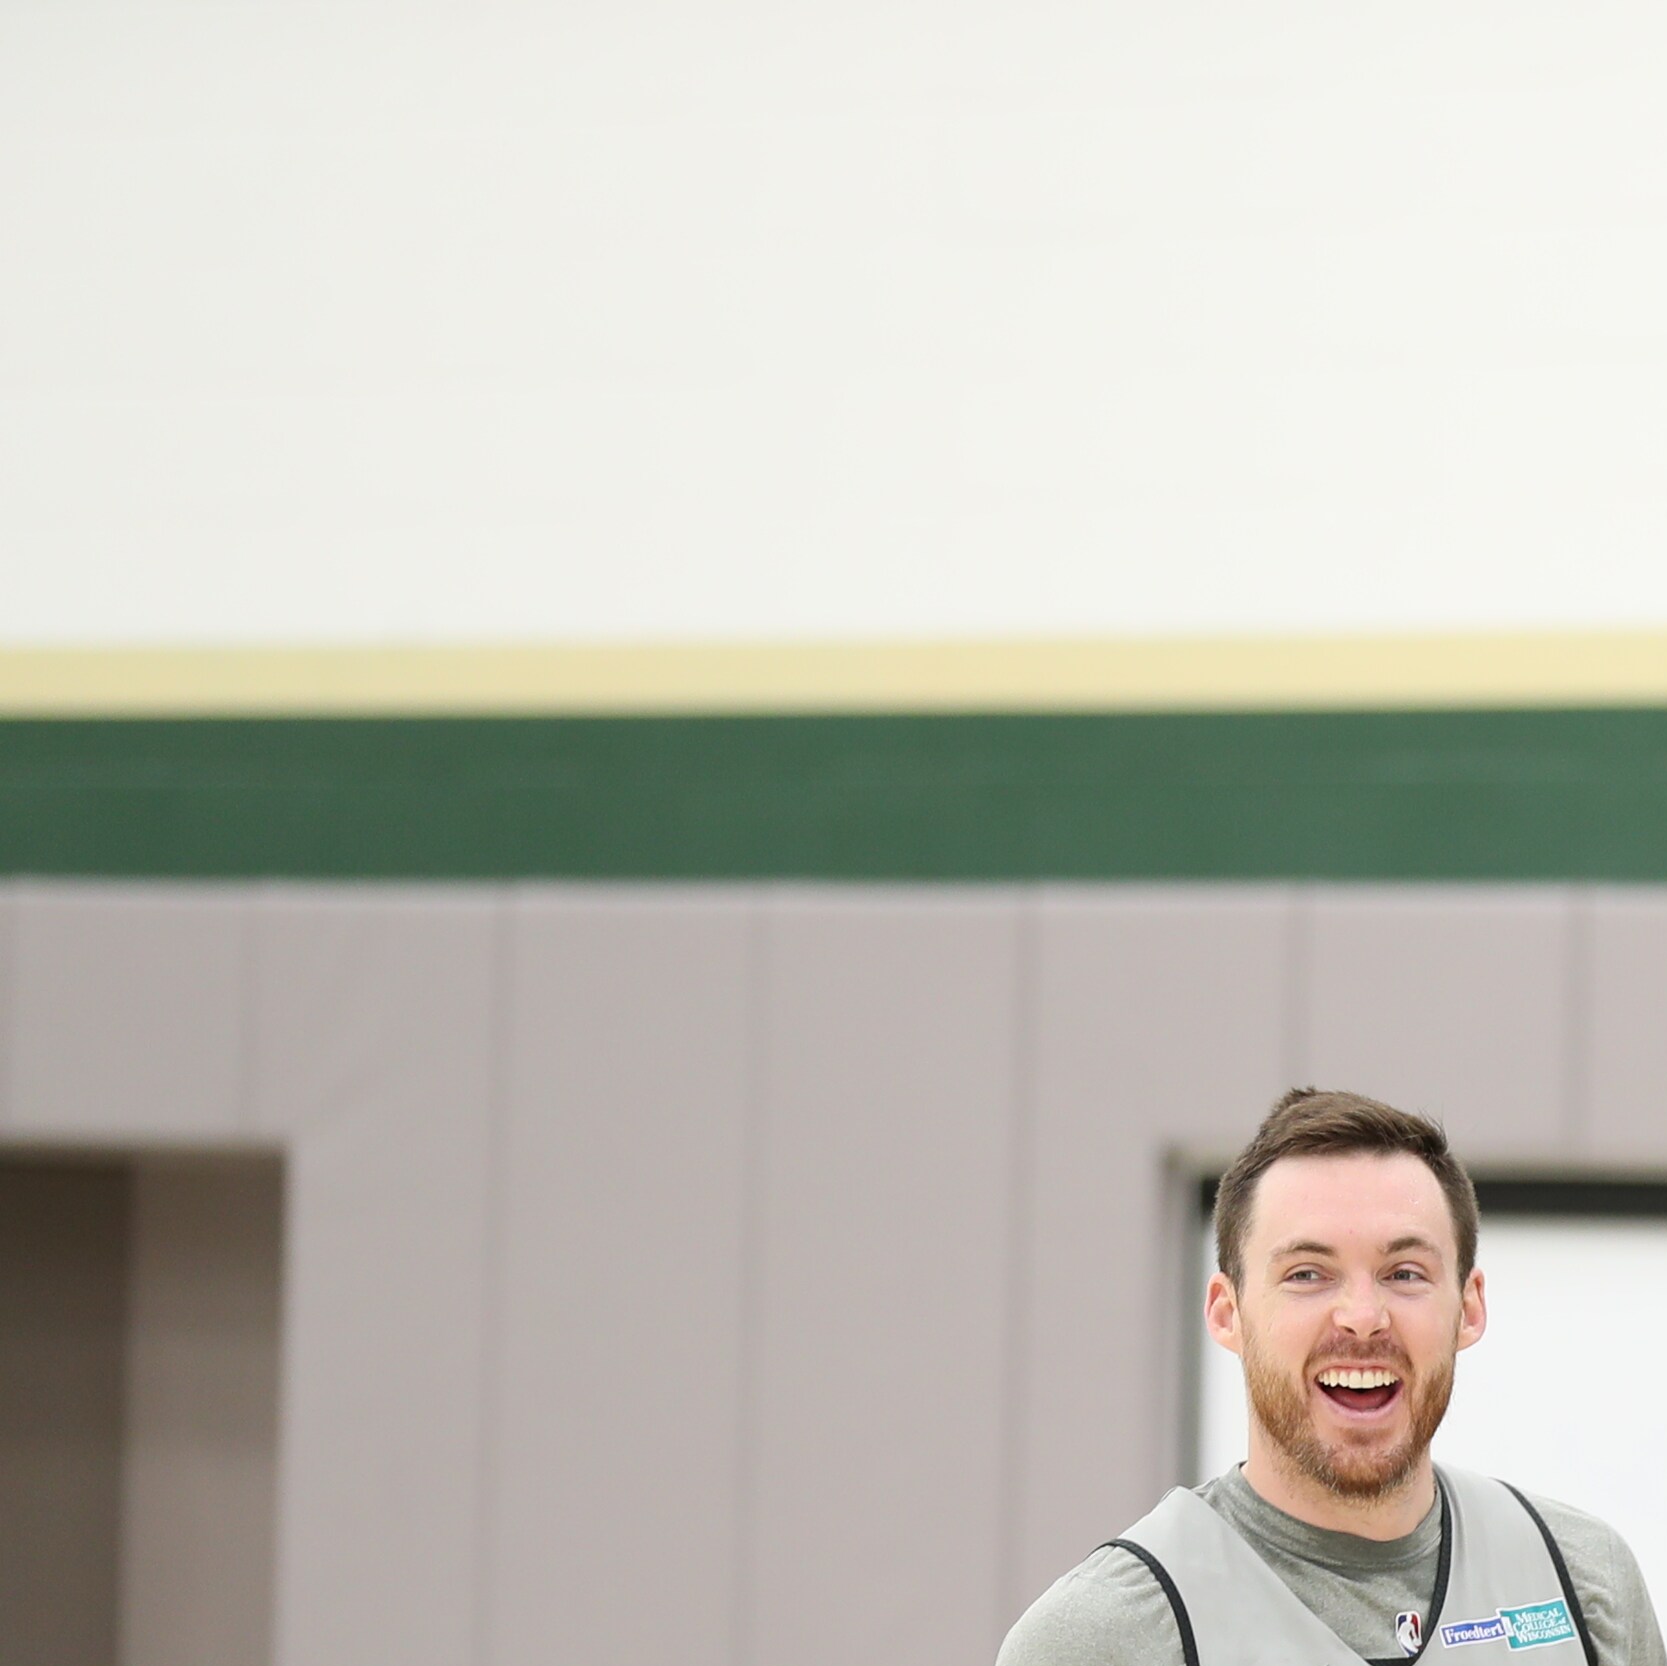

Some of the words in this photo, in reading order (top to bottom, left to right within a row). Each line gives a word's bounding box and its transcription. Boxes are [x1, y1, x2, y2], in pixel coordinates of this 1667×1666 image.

[1515, 1608, 1563, 1624] MEDICAL
[1445, 1623, 1504, 1643] Froedtert
[1513, 1619, 1558, 1634] COLLEGE
[1516, 1624, 1572, 1643] WISCONSIN
